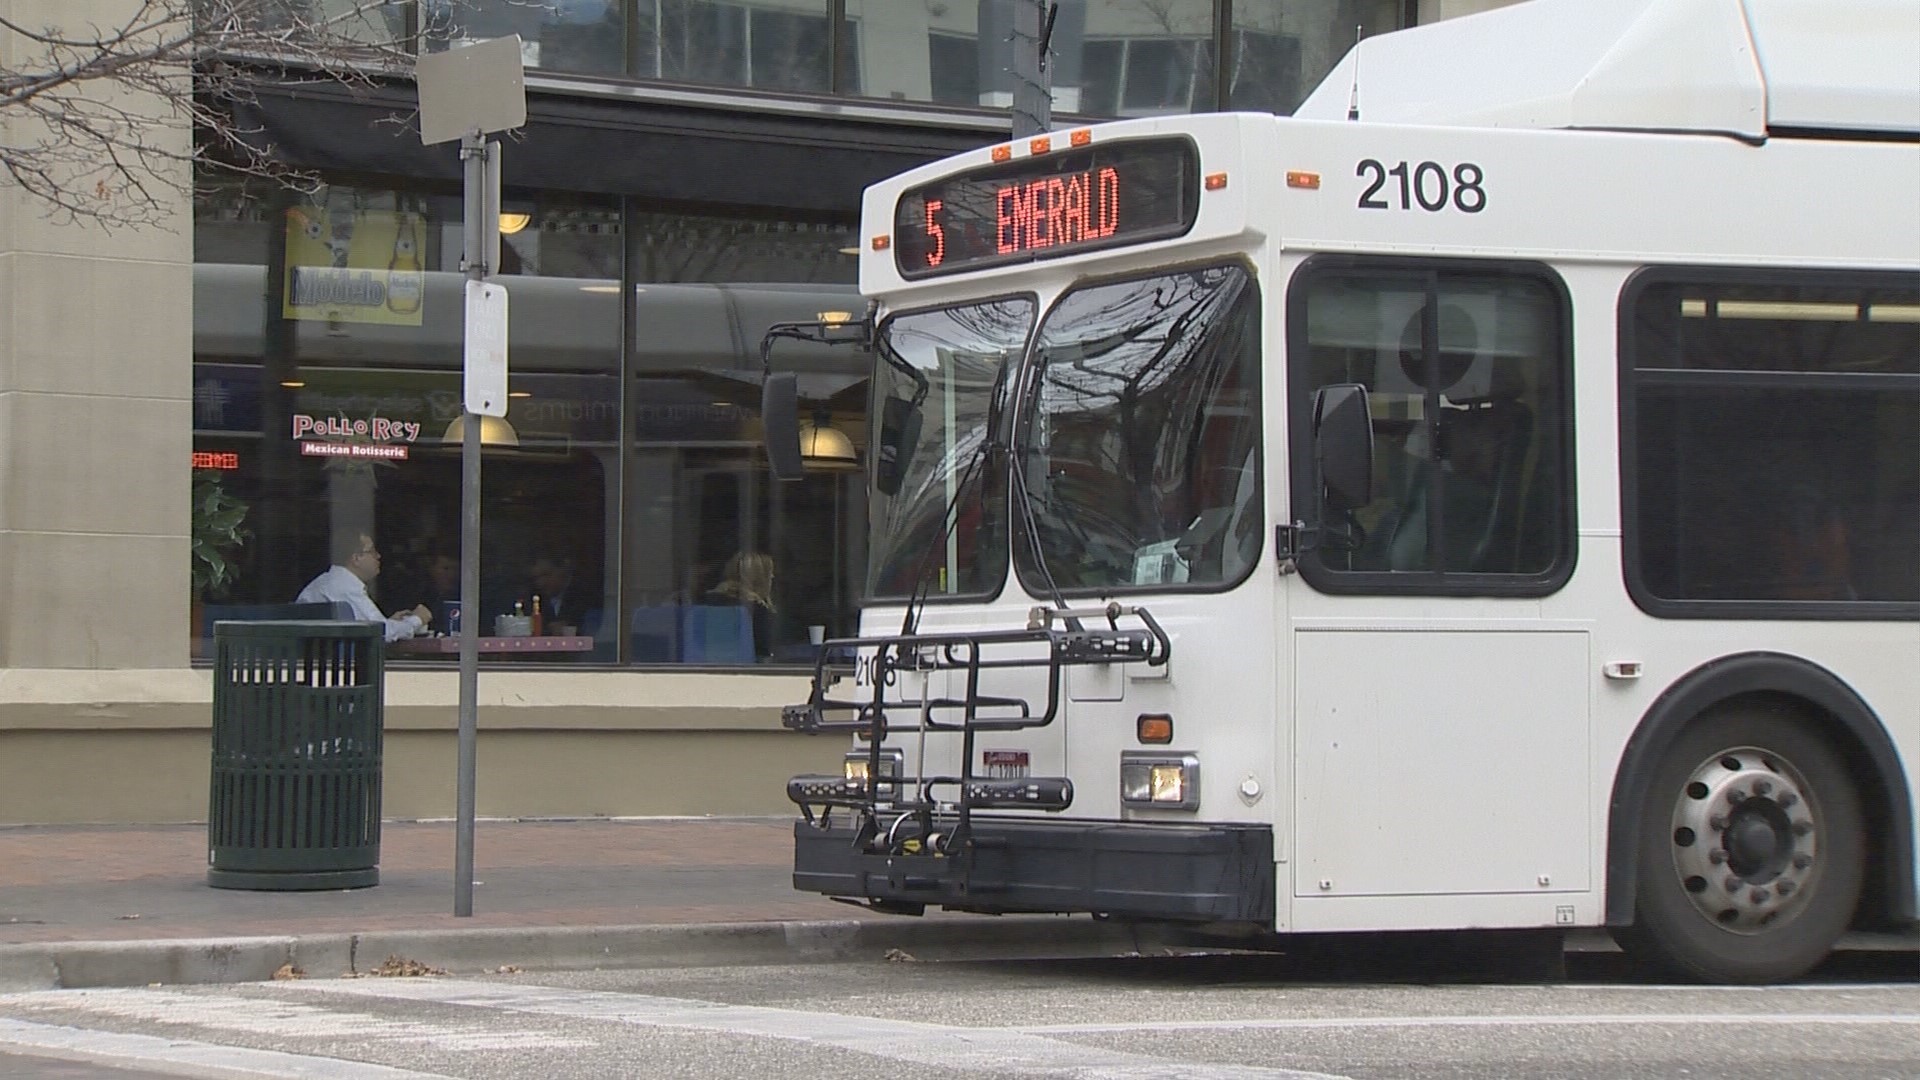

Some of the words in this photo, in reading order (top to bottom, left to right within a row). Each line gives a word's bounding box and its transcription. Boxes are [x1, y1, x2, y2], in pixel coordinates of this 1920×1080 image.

[1356, 159, 1487, 213] 2108
[925, 200, 944, 267] 5
[996, 166, 1119, 255] EMERALD
[305, 443, 350, 455] Mexican
[352, 445, 405, 457] Rotisserie
